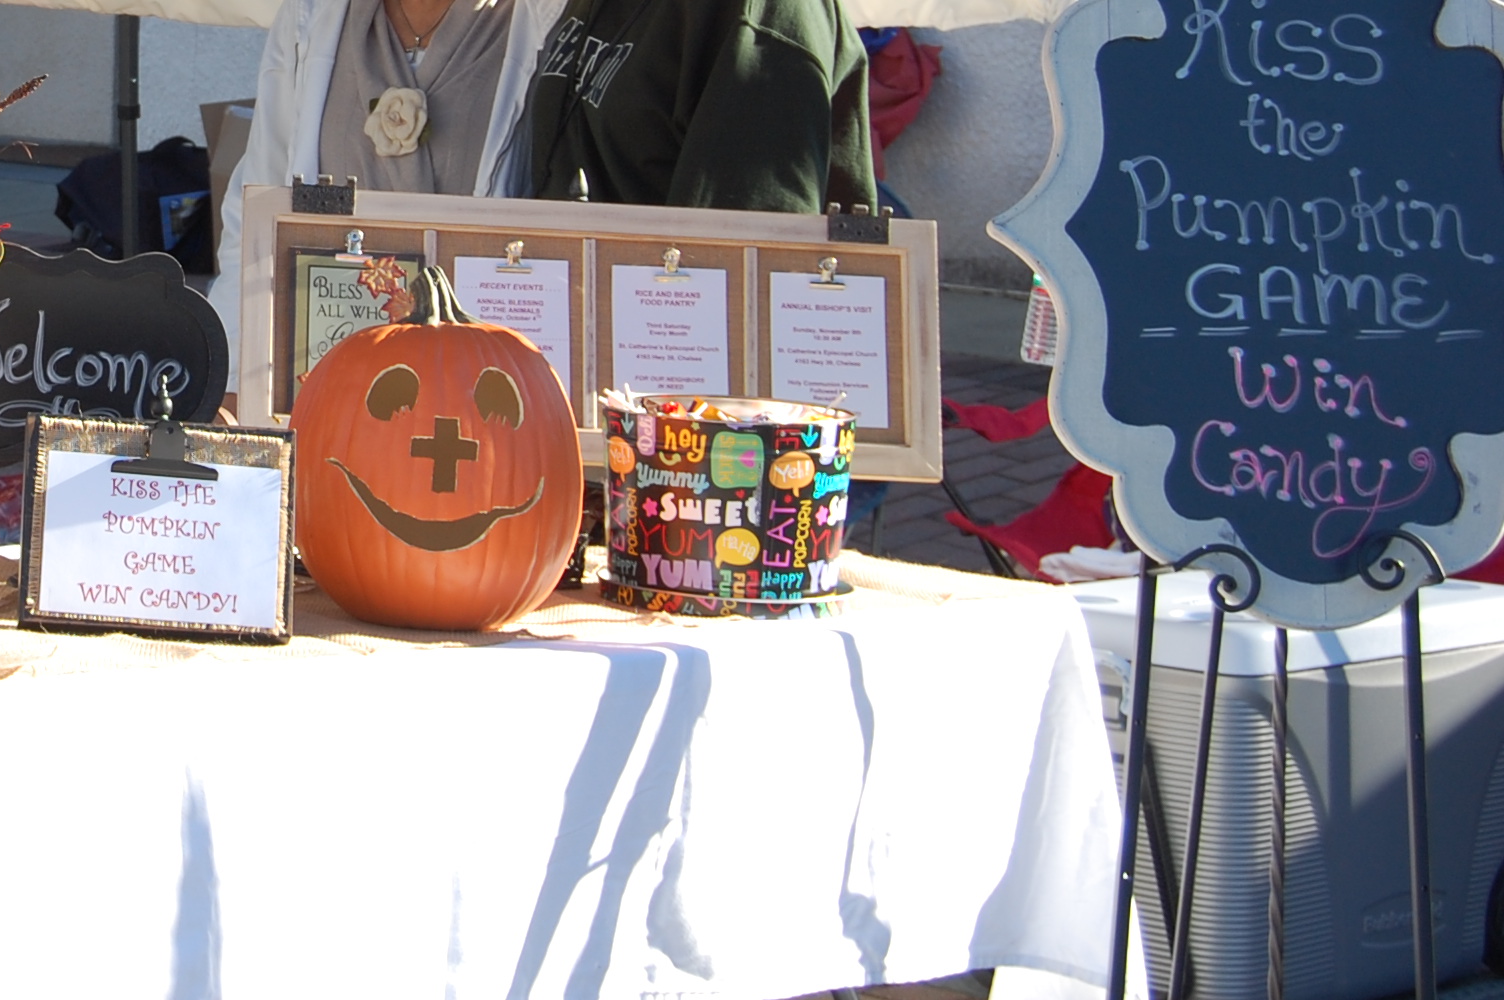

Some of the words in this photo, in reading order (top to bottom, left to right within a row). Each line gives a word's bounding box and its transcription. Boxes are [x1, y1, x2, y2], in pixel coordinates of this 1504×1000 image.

[1239, 93, 1344, 162] the
[1119, 154, 1495, 276] Pumpkin
[479, 282, 511, 290] RECENT
[513, 283, 544, 291] EVENTS
[635, 289, 653, 297] RICE
[674, 291, 701, 299] BEANS
[1185, 262, 1450, 330] GAME
[316, 304, 344, 319] ALL
[508, 299, 544, 307] BLESSING
[665, 299, 696, 307] PANTRY
[781, 302, 812, 311] ANNUAL
[853, 305, 872, 313] VISIT
[1227, 346, 1408, 428] Win
[664, 424, 707, 462] hey
[110, 477, 161, 500] KISS
[169, 480, 216, 507] THE
[636, 461, 710, 495] Yummy
[1191, 419, 1436, 558] Candy
[102, 510, 221, 540] PUMPKIN
[638, 518, 714, 560] YUM
[793, 499, 812, 568] POPCORN
[123, 550, 196, 575] GAME
[640, 553, 713, 591] YUM
[761, 570, 804, 590] Happy
[78, 582, 133, 605] WIN
[139, 588, 238, 614] CANDY!
